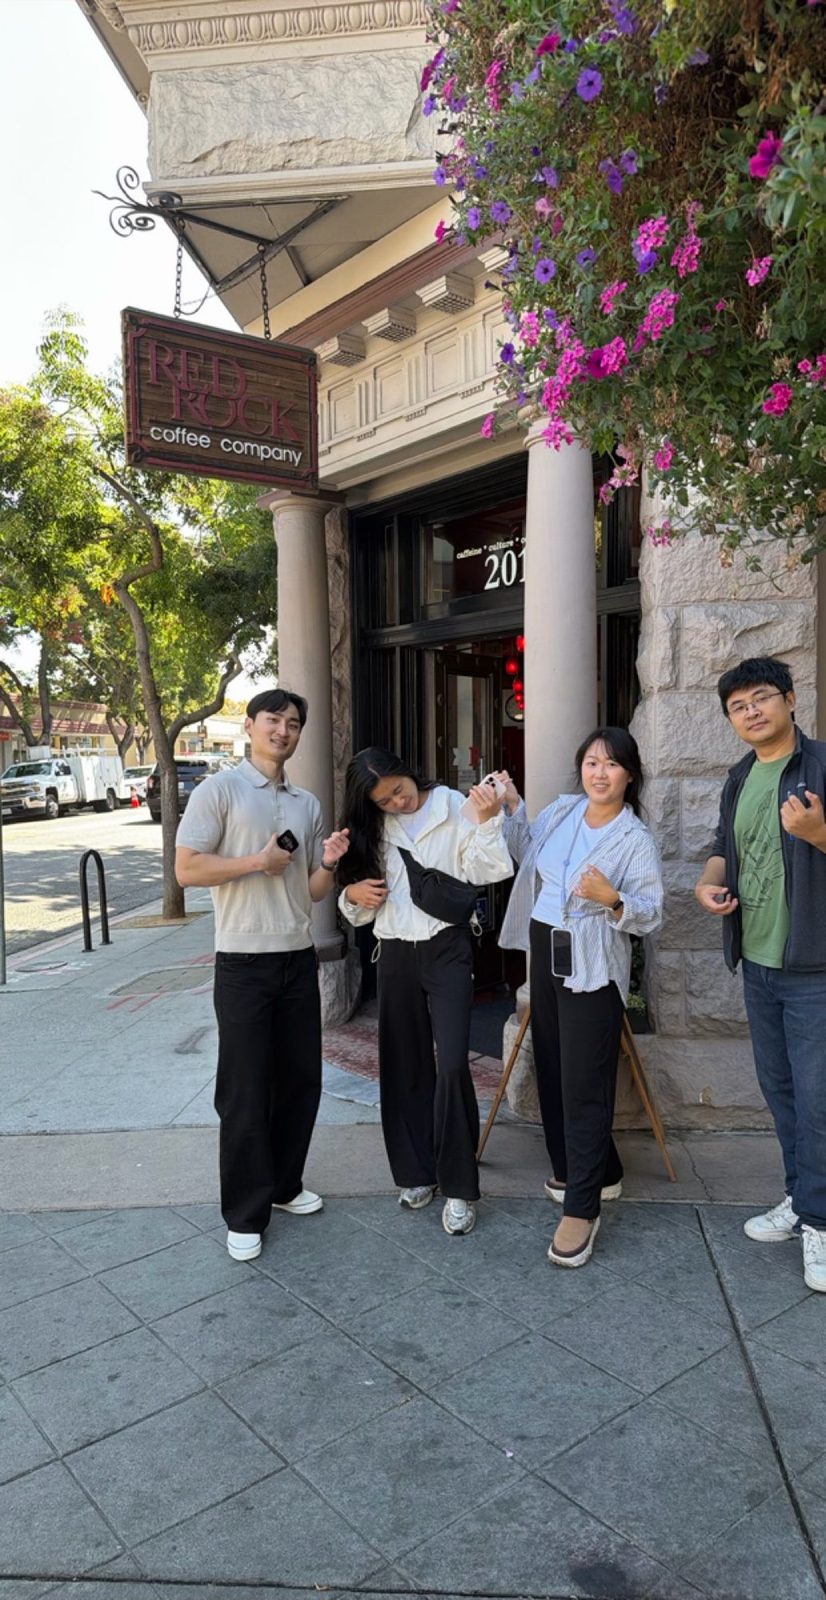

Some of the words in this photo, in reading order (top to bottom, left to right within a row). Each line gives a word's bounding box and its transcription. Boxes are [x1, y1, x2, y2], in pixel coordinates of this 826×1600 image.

[148, 340, 247, 400] RED
[171, 386, 302, 441] ROCK
[150, 425, 211, 449] coffee
[220, 438, 302, 467] company
[456, 548, 482, 559] caffeine
[488, 540, 514, 552] culture
